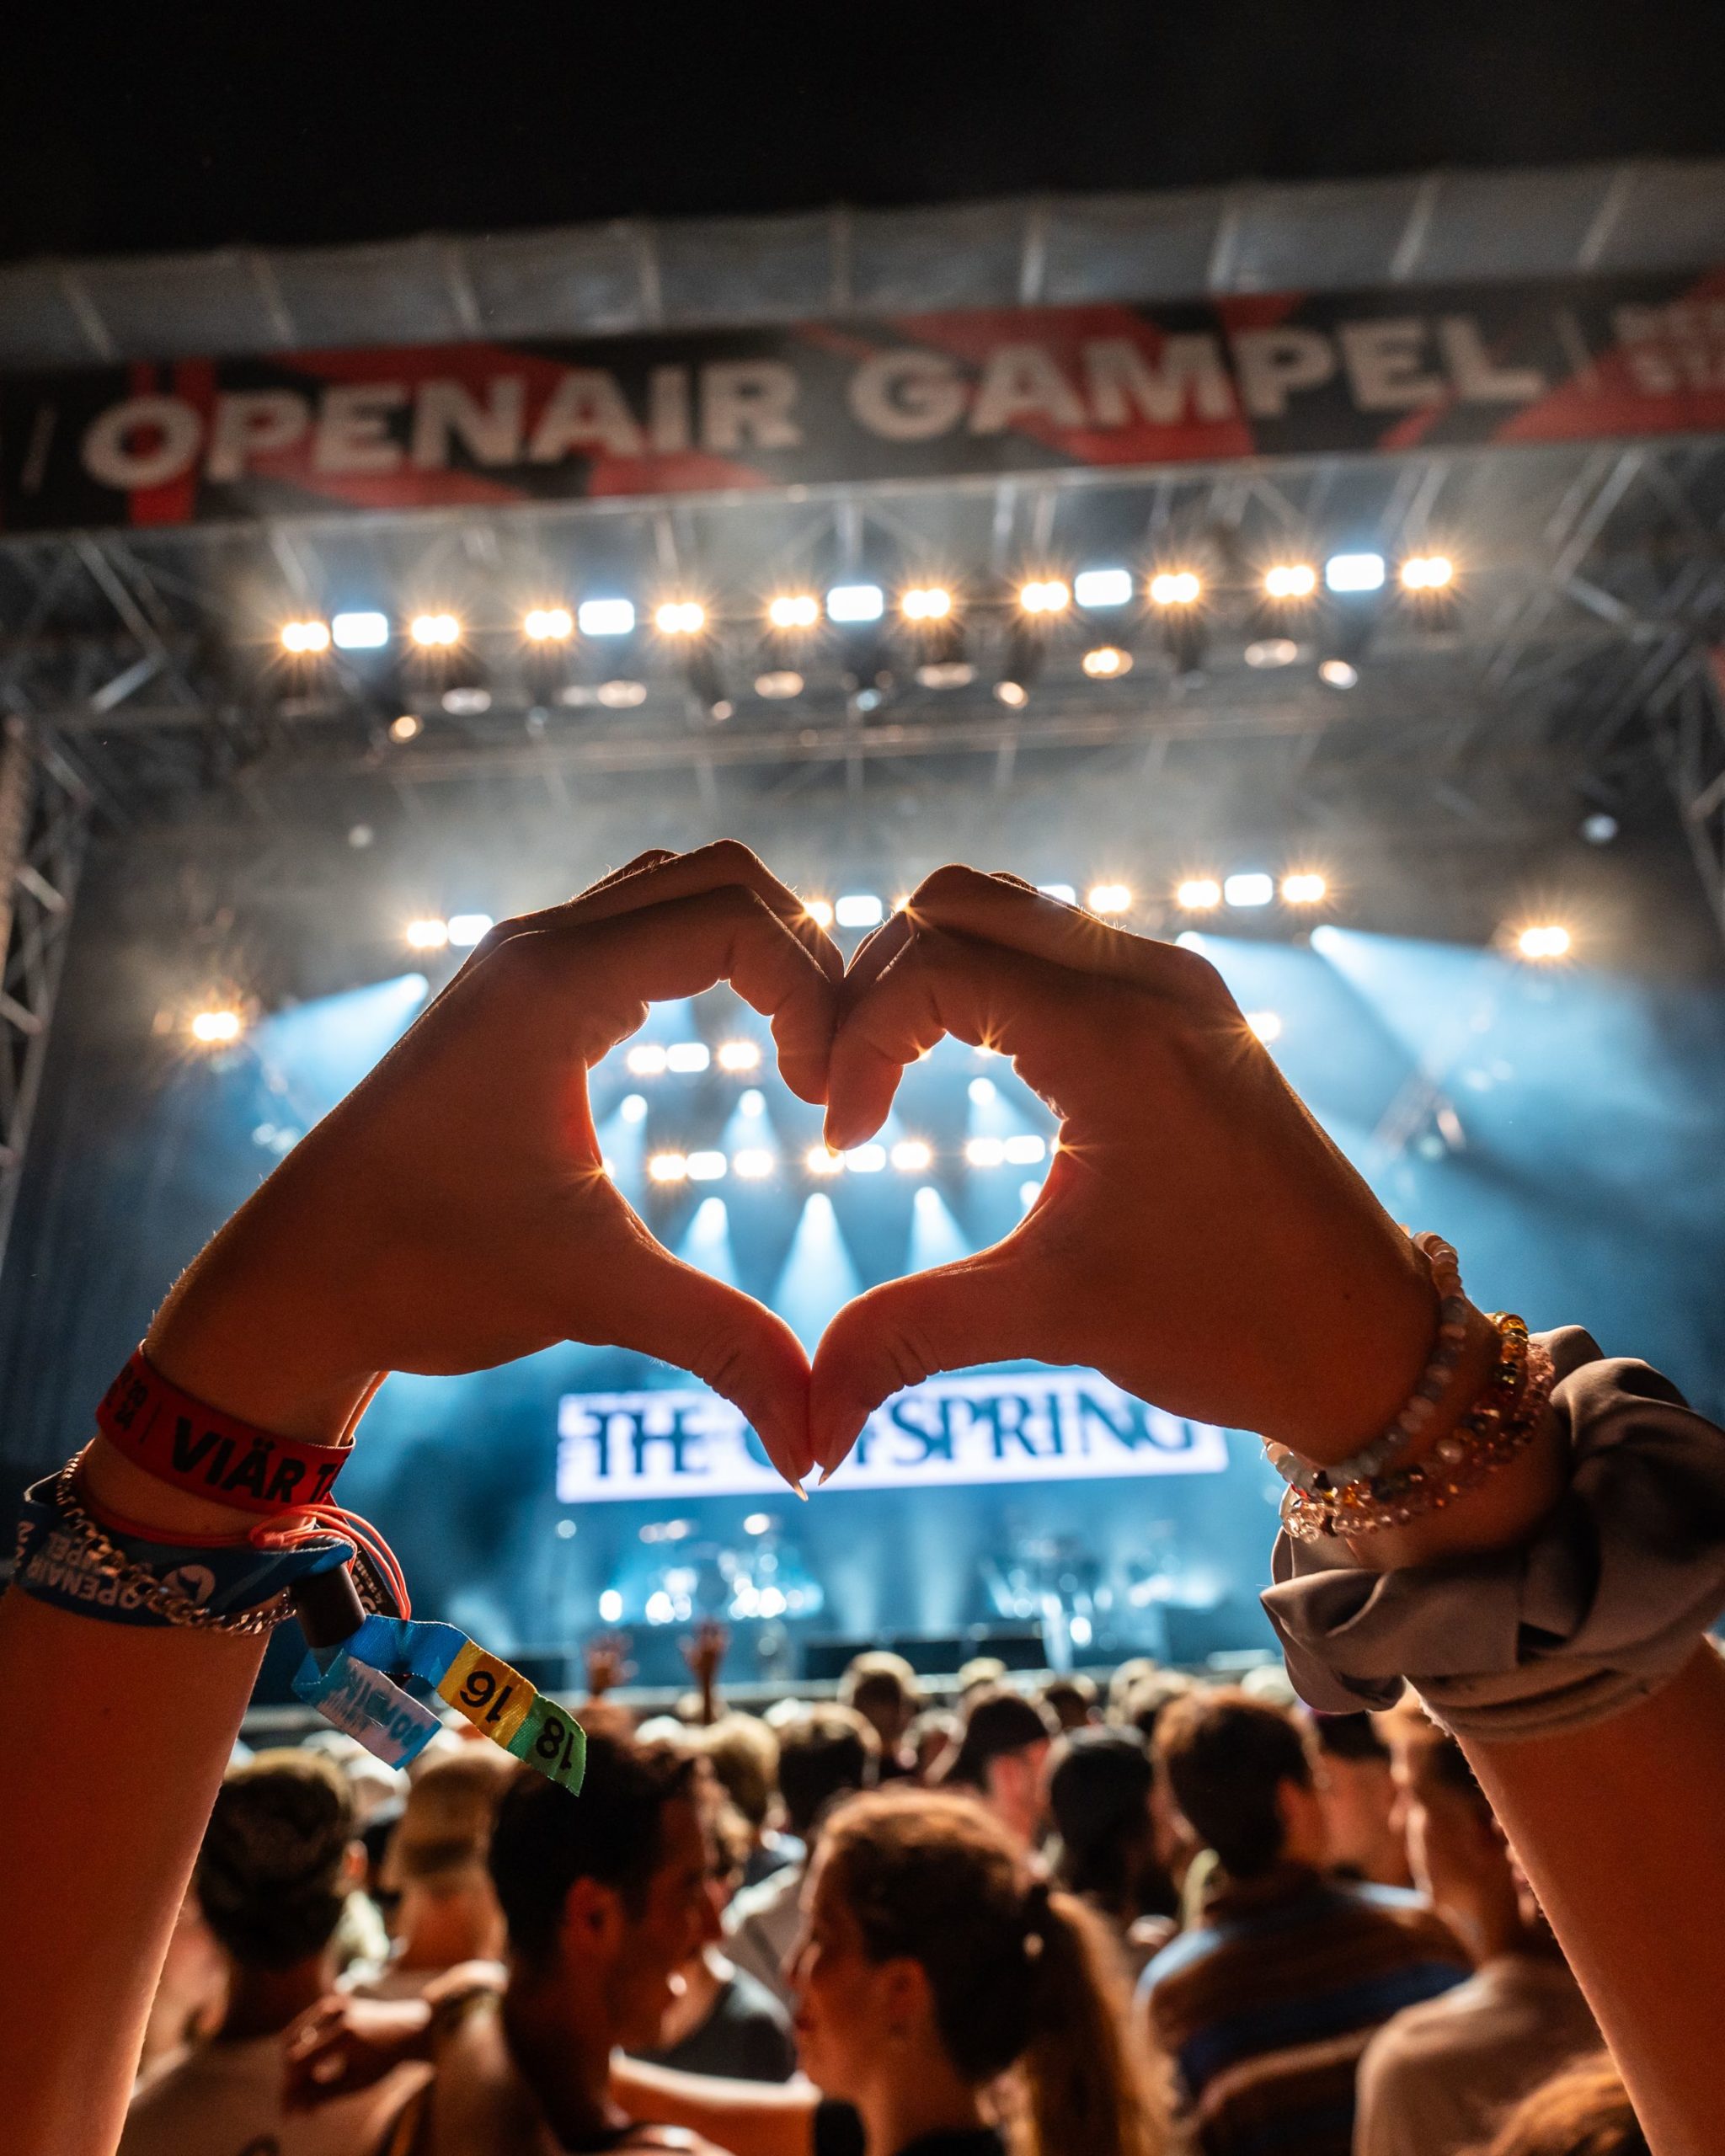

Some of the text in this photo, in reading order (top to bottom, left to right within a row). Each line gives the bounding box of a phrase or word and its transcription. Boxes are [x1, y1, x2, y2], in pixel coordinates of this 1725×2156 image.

[79, 359, 803, 490] OPENAIR
[848, 312, 1546, 442] GAMPEL
[171, 1417, 306, 1503] VIÄR
[584, 1405, 708, 1476] THE
[460, 1671, 513, 1723] 16
[536, 1718, 574, 1770] 18
